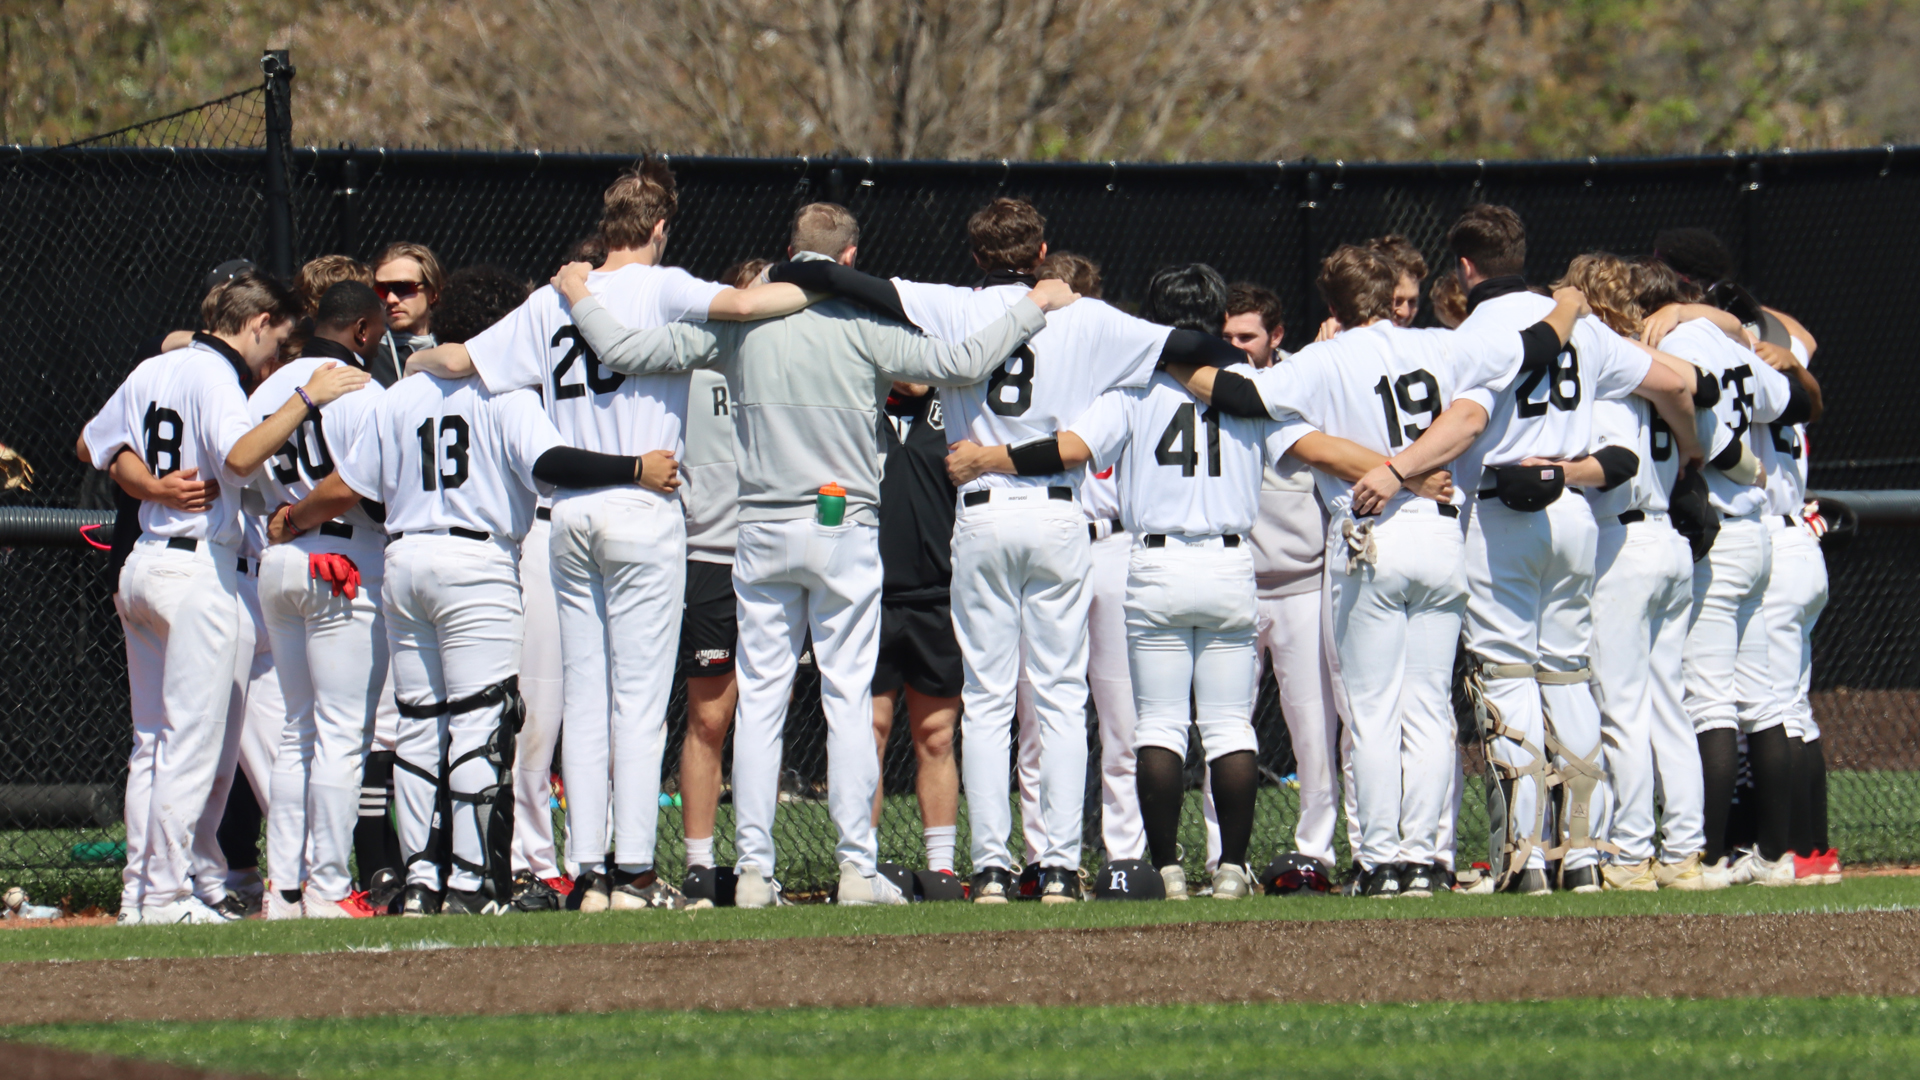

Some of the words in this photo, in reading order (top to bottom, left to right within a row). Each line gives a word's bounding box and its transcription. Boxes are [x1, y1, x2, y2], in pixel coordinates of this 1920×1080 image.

[986, 343, 1035, 417] 8
[1374, 368, 1442, 448] 19
[416, 415, 470, 491] 13
[1154, 402, 1221, 477] 41
[1108, 870, 1129, 893] R
